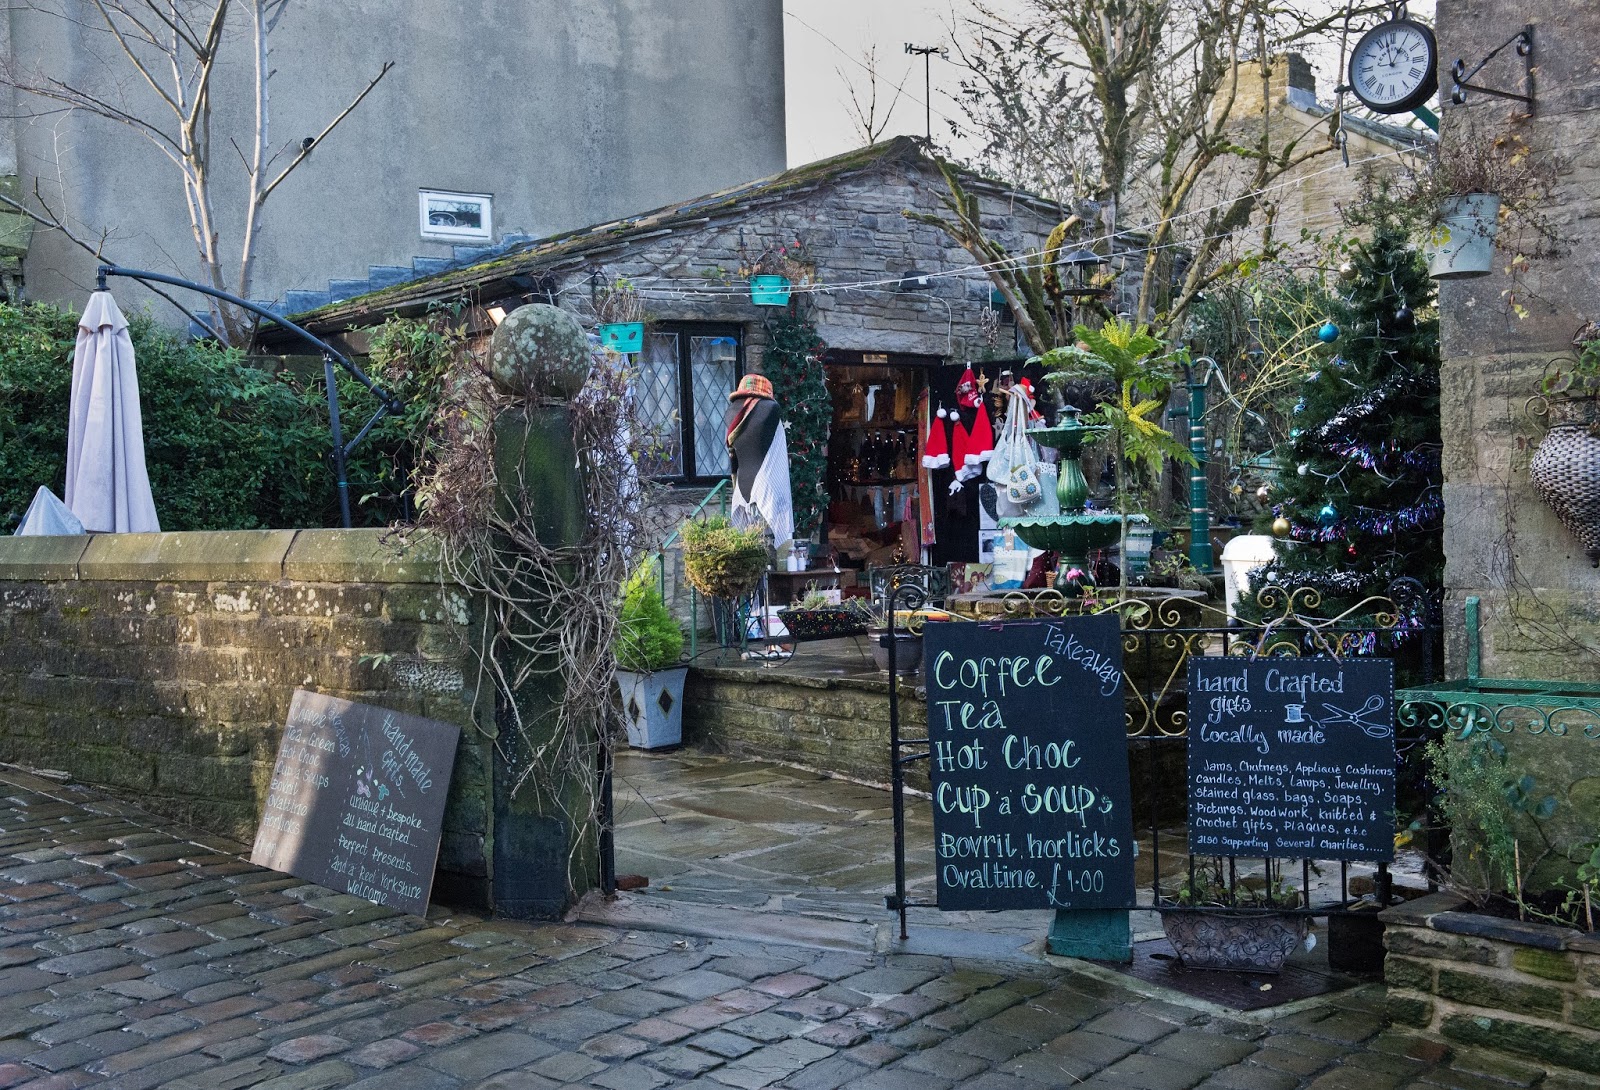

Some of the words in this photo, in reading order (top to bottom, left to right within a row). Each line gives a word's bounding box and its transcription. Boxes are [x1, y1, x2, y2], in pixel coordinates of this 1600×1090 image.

[934, 650, 1061, 697] Coffee
[1197, 668, 1248, 692] hand
[1265, 668, 1343, 702] Crafted
[935, 700, 1006, 730] Tea
[1277, 725, 1326, 744] made
[935, 738, 988, 771] Hot
[1002, 734, 1081, 770] Choc
[937, 781, 990, 828] Cup
